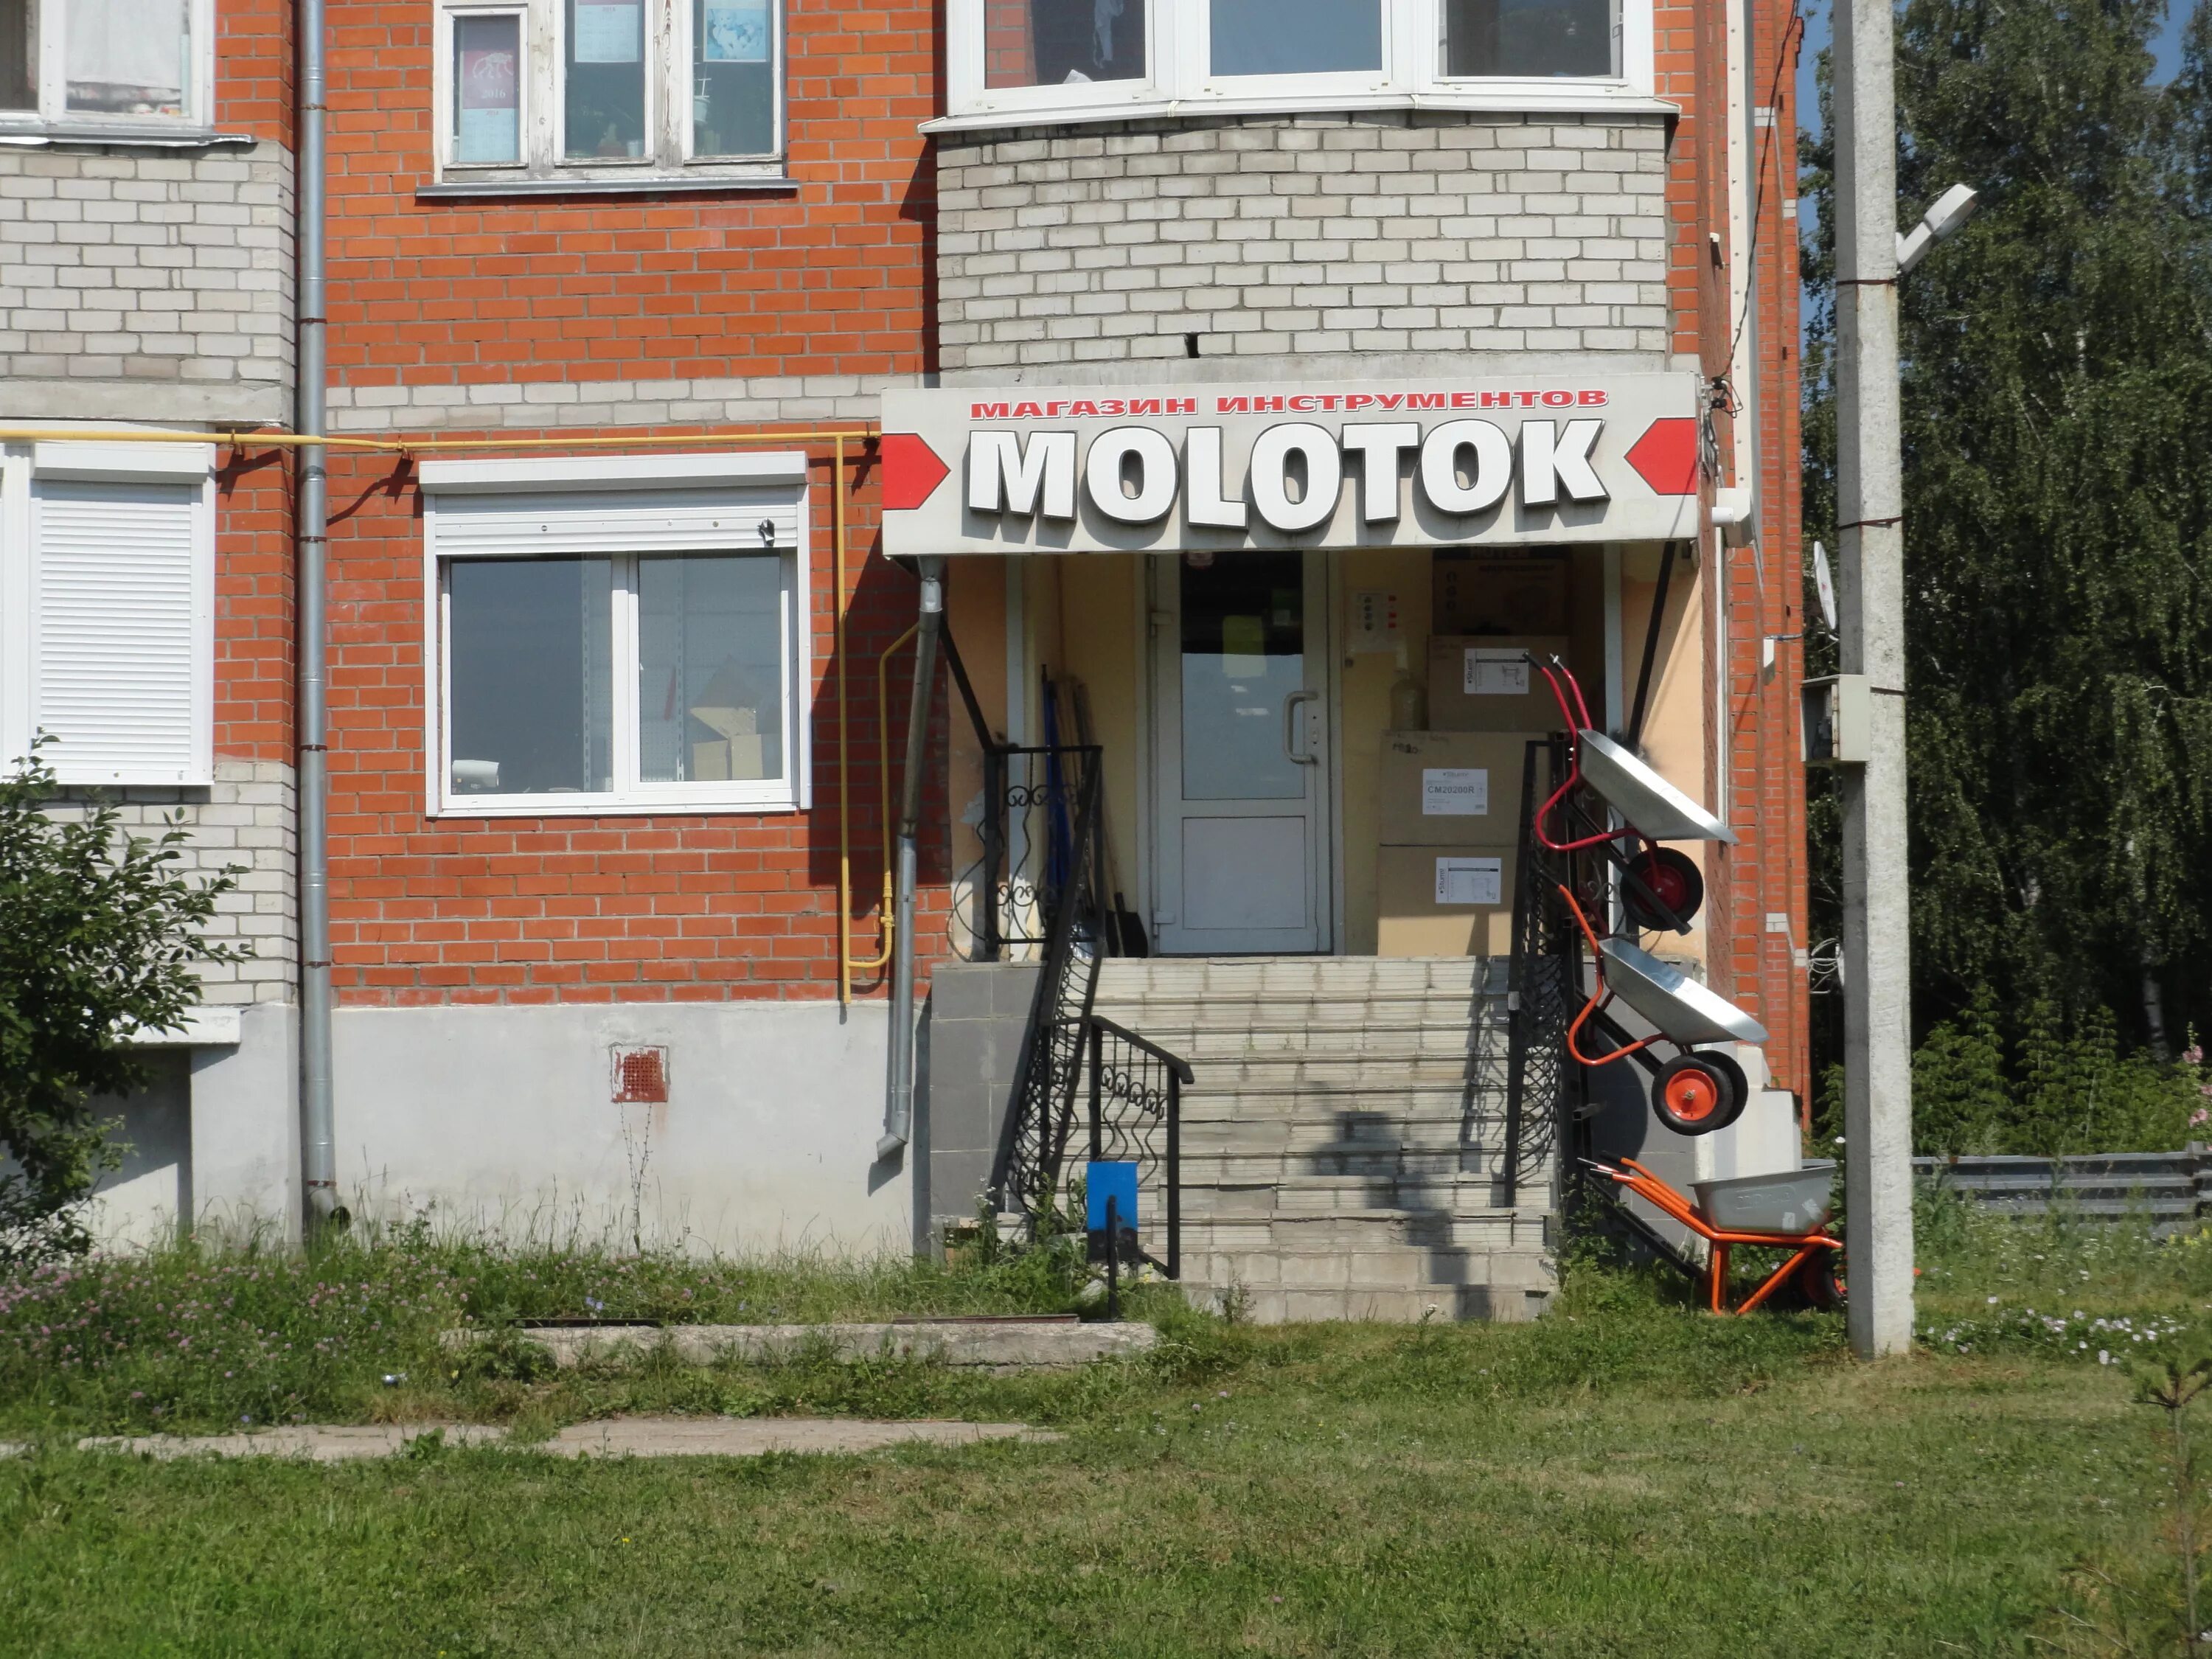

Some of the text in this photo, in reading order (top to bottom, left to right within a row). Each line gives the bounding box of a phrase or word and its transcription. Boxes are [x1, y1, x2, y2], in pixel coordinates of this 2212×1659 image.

[481, 88, 507, 99] 2016
[970, 389, 1609, 419] МАГАЗИН ИНСТРУМЕНТОВ
[968, 419, 1611, 533] MOLOTOK
[1427, 785, 1475, 794] CM20200R
